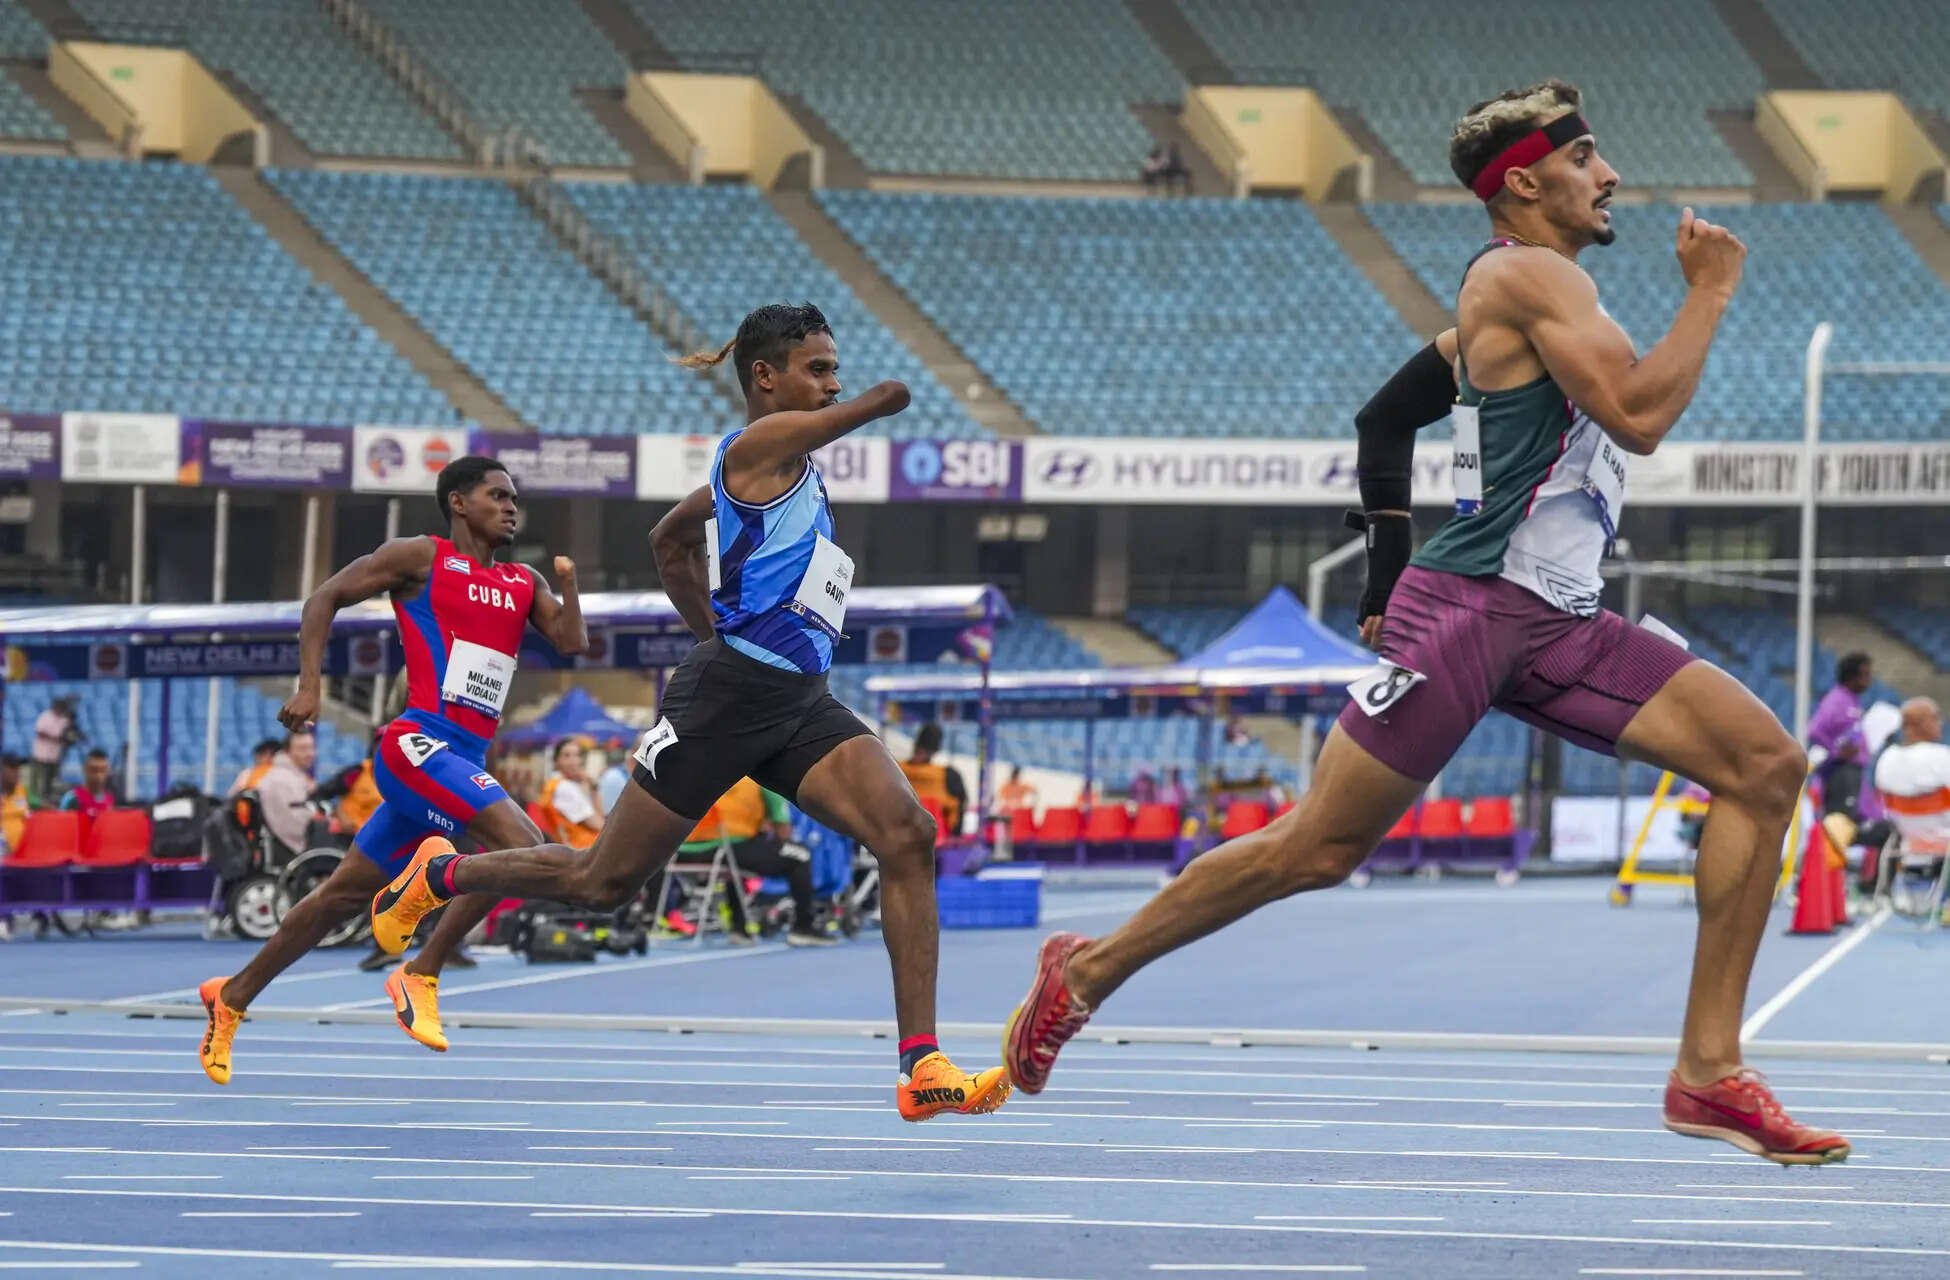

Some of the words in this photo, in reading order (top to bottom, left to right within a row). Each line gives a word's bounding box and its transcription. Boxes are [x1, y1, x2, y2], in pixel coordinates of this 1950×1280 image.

[941, 441, 1010, 488] SBI
[1114, 455, 1303, 488] HYUNDAI
[1695, 454, 1797, 492] MINISTRY
[1841, 454, 1910, 492] YOUTH
[468, 584, 516, 611] CUBA
[825, 580, 844, 606] GAVIT
[146, 648, 200, 666] NEW
[206, 648, 273, 665] DELHI
[468, 670, 503, 692] MILANES
[1366, 667, 1414, 707] 8
[410, 735, 433, 757] 5
[427, 809, 454, 832] CUBA
[909, 1088, 966, 1107] NITRO
